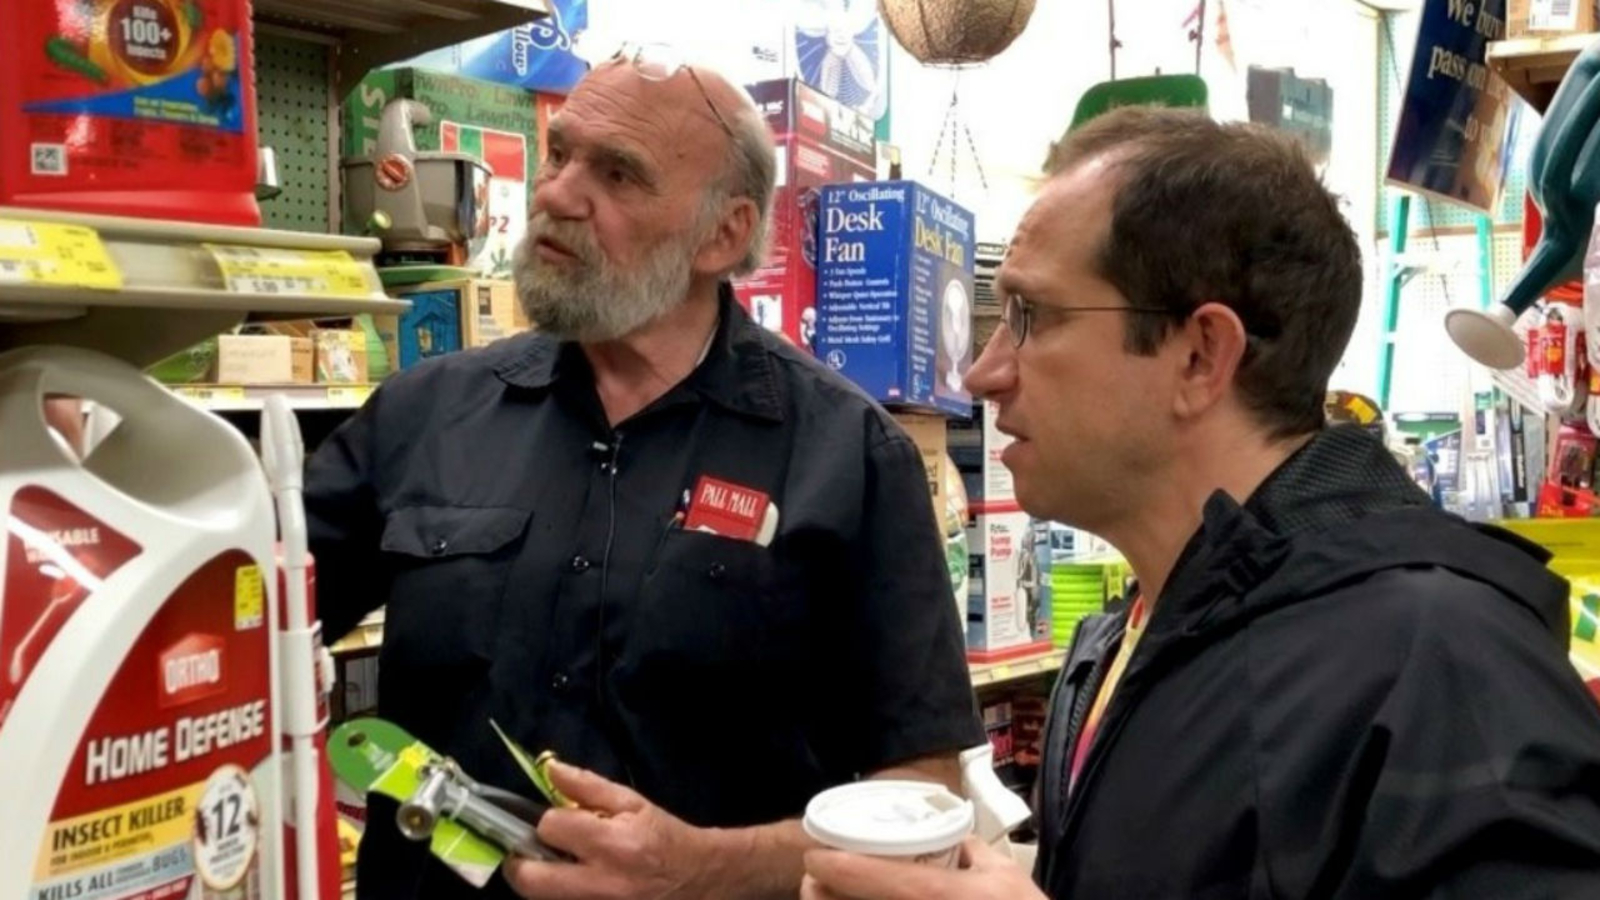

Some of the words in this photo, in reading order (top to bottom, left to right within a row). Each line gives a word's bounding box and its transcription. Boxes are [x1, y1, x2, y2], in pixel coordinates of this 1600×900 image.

[120, 17, 173, 46] 100+
[1427, 45, 1467, 80] pass
[825, 202, 885, 233] Desk
[824, 236, 866, 263] Fan
[915, 214, 944, 257] Desk
[945, 229, 965, 268] Fan
[700, 483, 728, 509] PALL
[727, 491, 758, 518] MALL
[165, 648, 220, 694] ORTHO
[85, 727, 169, 786] HOME
[174, 699, 266, 762] DEFENSE
[53, 813, 123, 851] INSECT
[128, 796, 185, 831] KILLER
[212, 793, 242, 840] 12
[38, 880, 82, 900] KILLS
[87, 871, 113, 893] ALL
